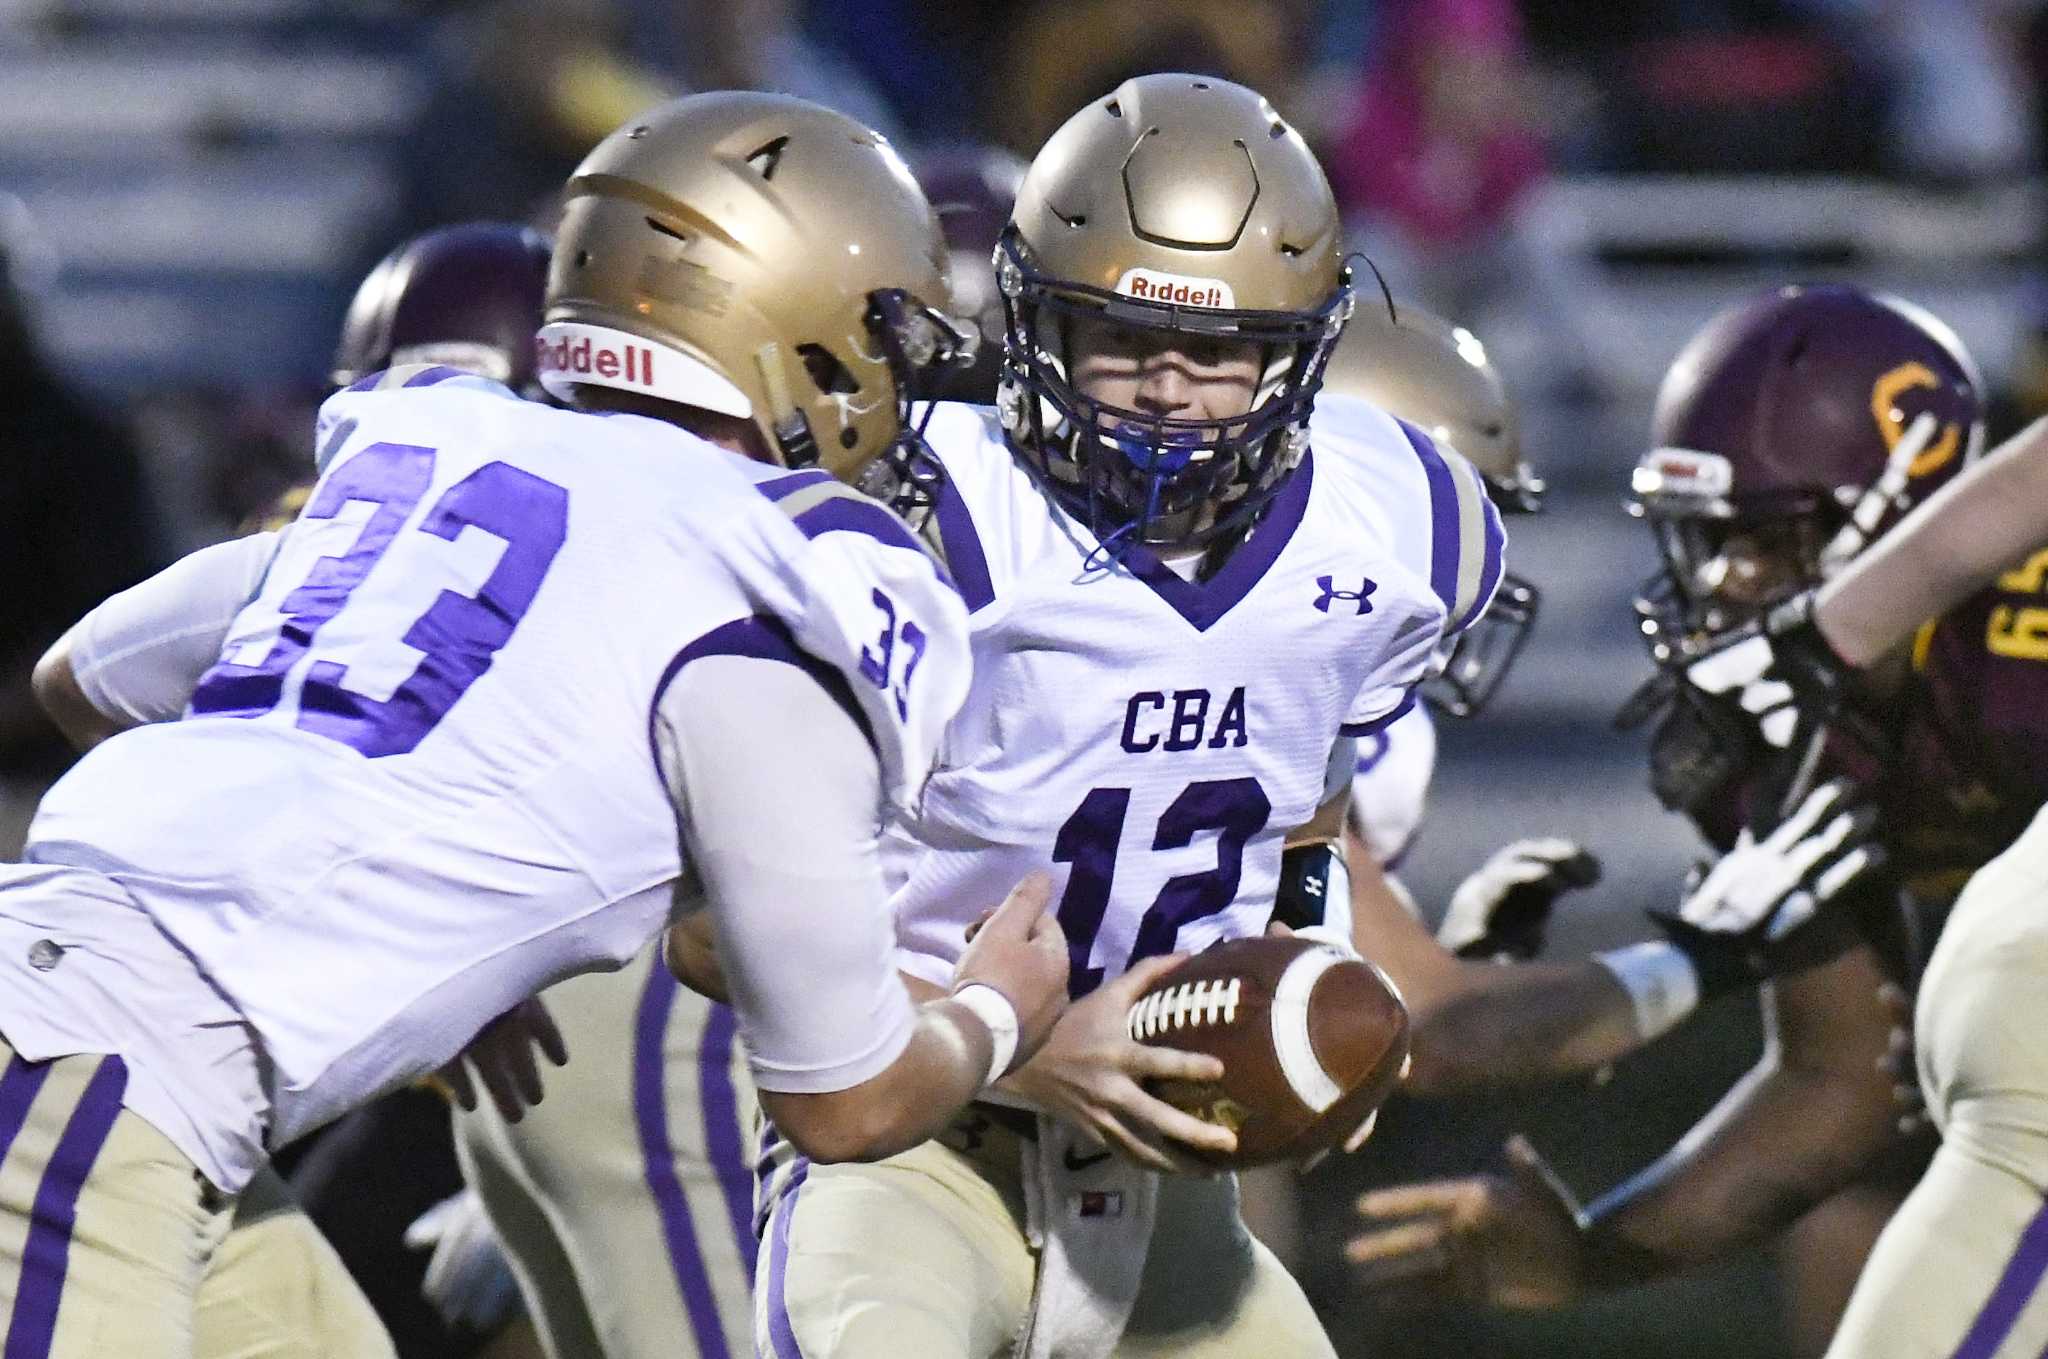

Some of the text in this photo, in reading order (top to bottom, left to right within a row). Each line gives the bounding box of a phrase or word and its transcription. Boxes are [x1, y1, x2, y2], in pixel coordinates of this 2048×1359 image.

[1132, 277, 1221, 307] Riddell
[1871, 361, 1961, 477] C
[191, 442, 569, 758] 33
[1120, 686, 1248, 753] CBA
[1052, 776, 1272, 1001] 12
